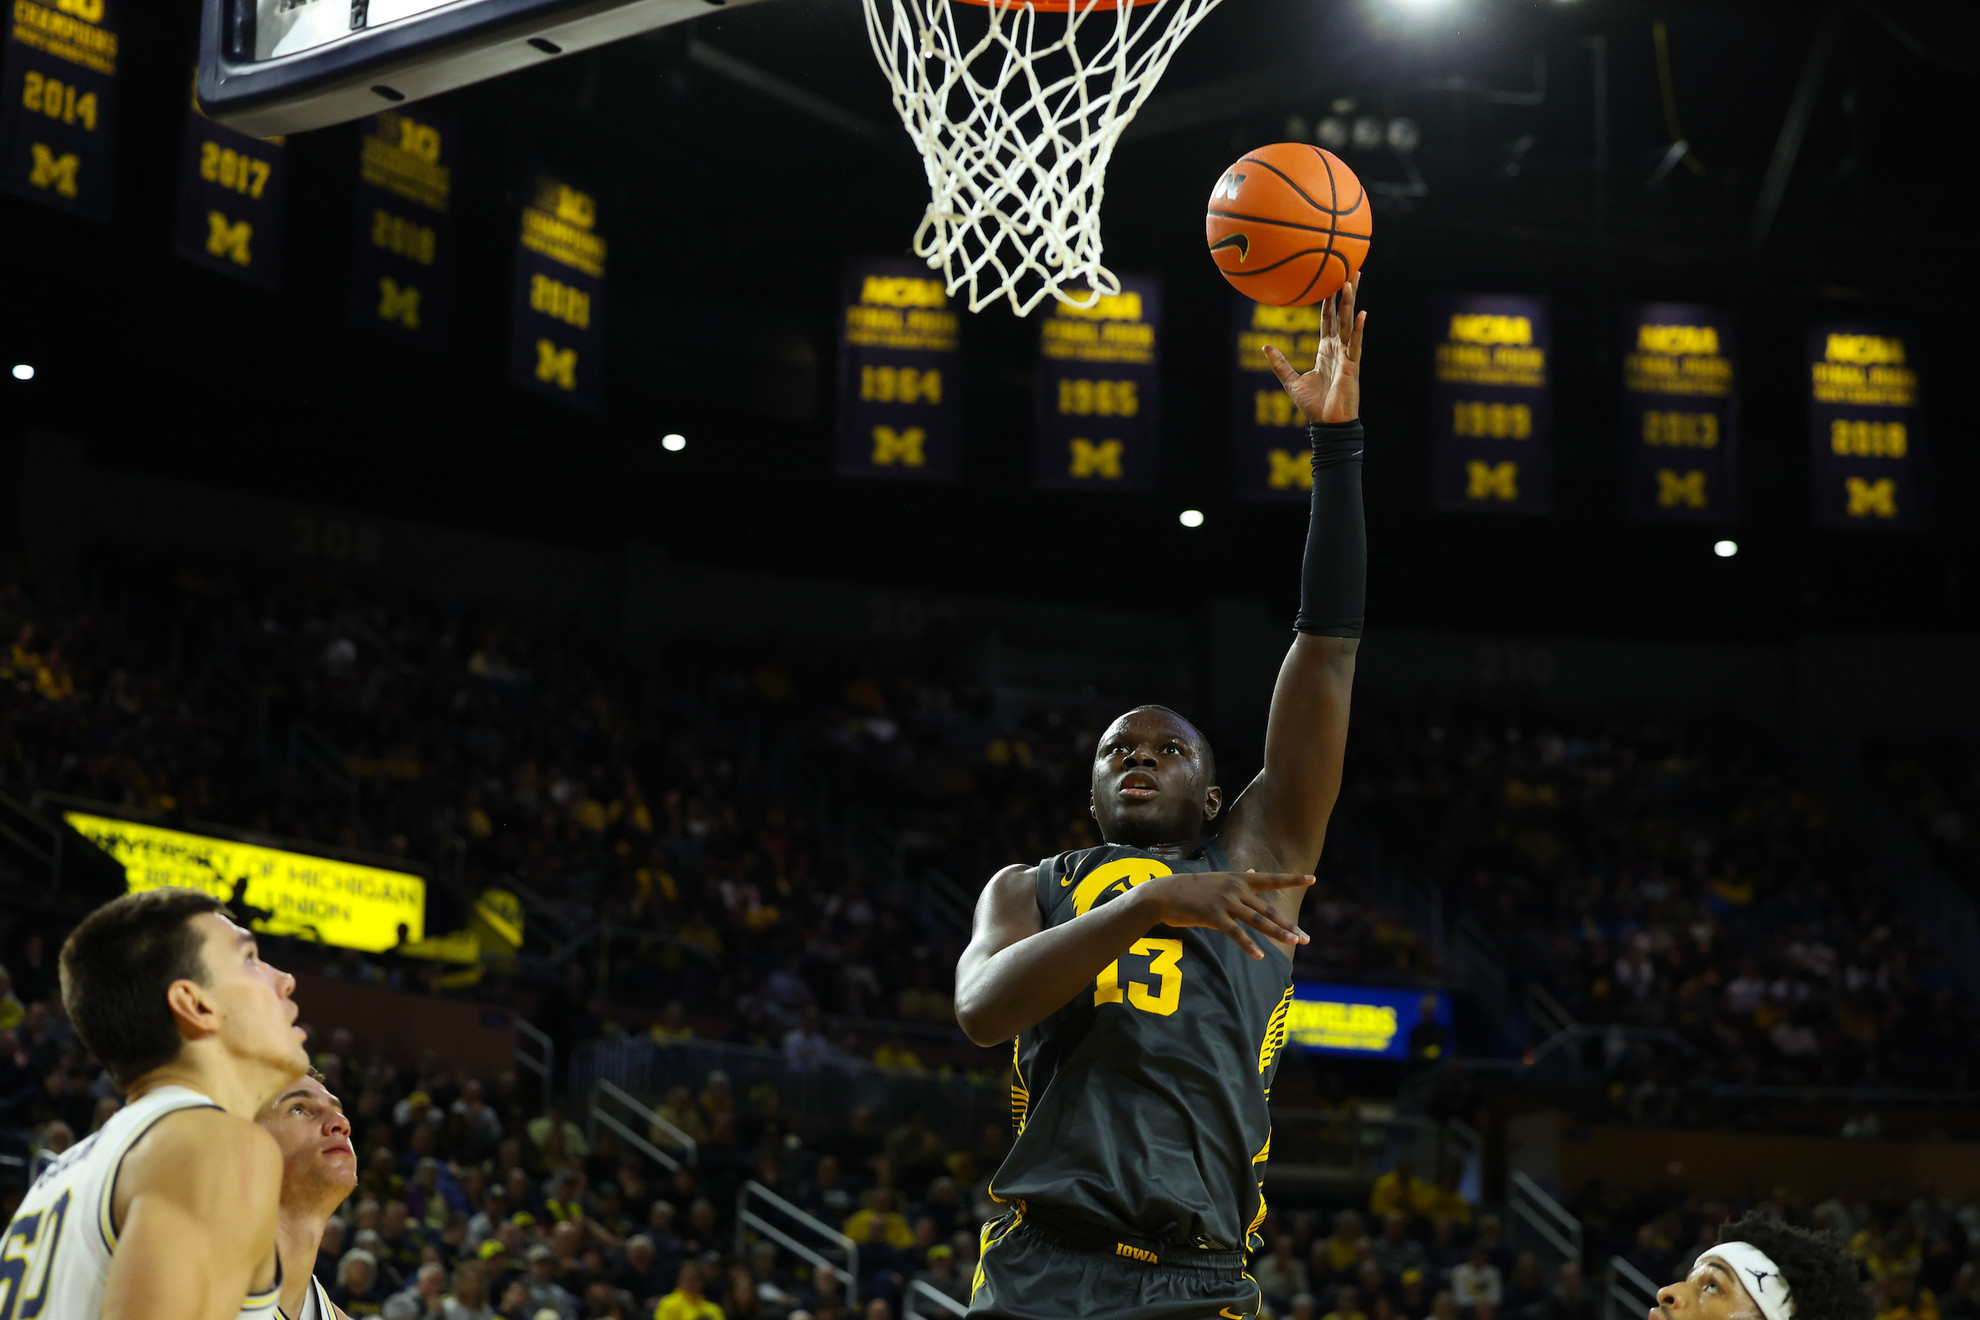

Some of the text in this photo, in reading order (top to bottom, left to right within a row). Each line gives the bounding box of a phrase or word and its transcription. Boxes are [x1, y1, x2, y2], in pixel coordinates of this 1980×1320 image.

[22, 70, 98, 132] 2014
[29, 142, 80, 199] M
[200, 141, 271, 199] 2017
[206, 210, 253, 267] M
[534, 337, 579, 393] M
[871, 425, 928, 469] M
[1068, 437, 1125, 481] M
[1465, 459, 1520, 503] M
[1656, 468, 1708, 510] M
[1845, 475, 1899, 520] M
[1094, 937, 1185, 1017] 13
[1115, 1242, 1159, 1265] IOWA
